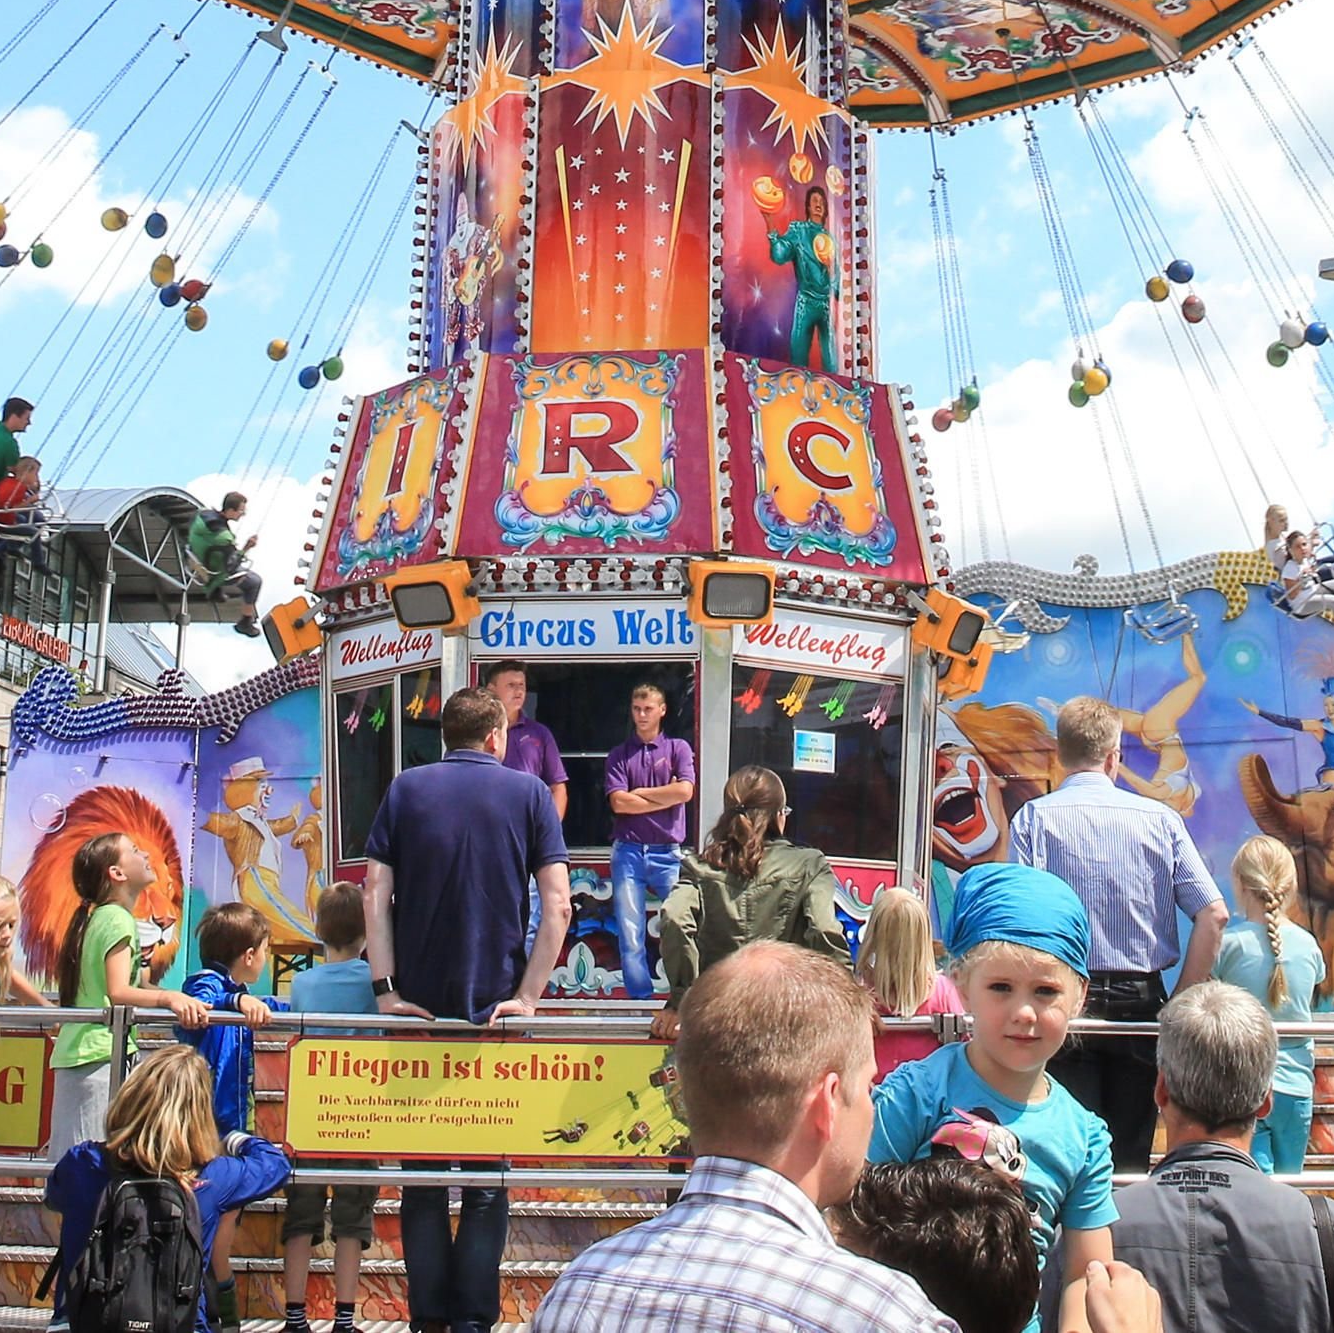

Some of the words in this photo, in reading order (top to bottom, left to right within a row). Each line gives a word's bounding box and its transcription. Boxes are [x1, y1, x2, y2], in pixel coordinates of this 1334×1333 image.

[539, 400, 641, 475] R
[787, 420, 854, 490] C
[480, 610, 596, 648] Circus
[612, 608, 695, 646] Welt
[746, 622, 887, 670] Wellenflug
[340, 630, 435, 667] Wellenflug
[306, 1049, 430, 1086] Fliegen
[442, 1053, 484, 1080] ist
[493, 1053, 605, 1083] schön!
[317, 1111, 393, 1126] abgestoßen
[395, 1112, 427, 1125] oder
[429, 1112, 514, 1127] festgehalten
[318, 1094, 341, 1106] Die
[343, 1094, 432, 1108] Nachbarsitze
[435, 1096, 482, 1109] dürfen
[485, 1097, 521, 1109] nicht
[317, 1128, 371, 1140] werden!
